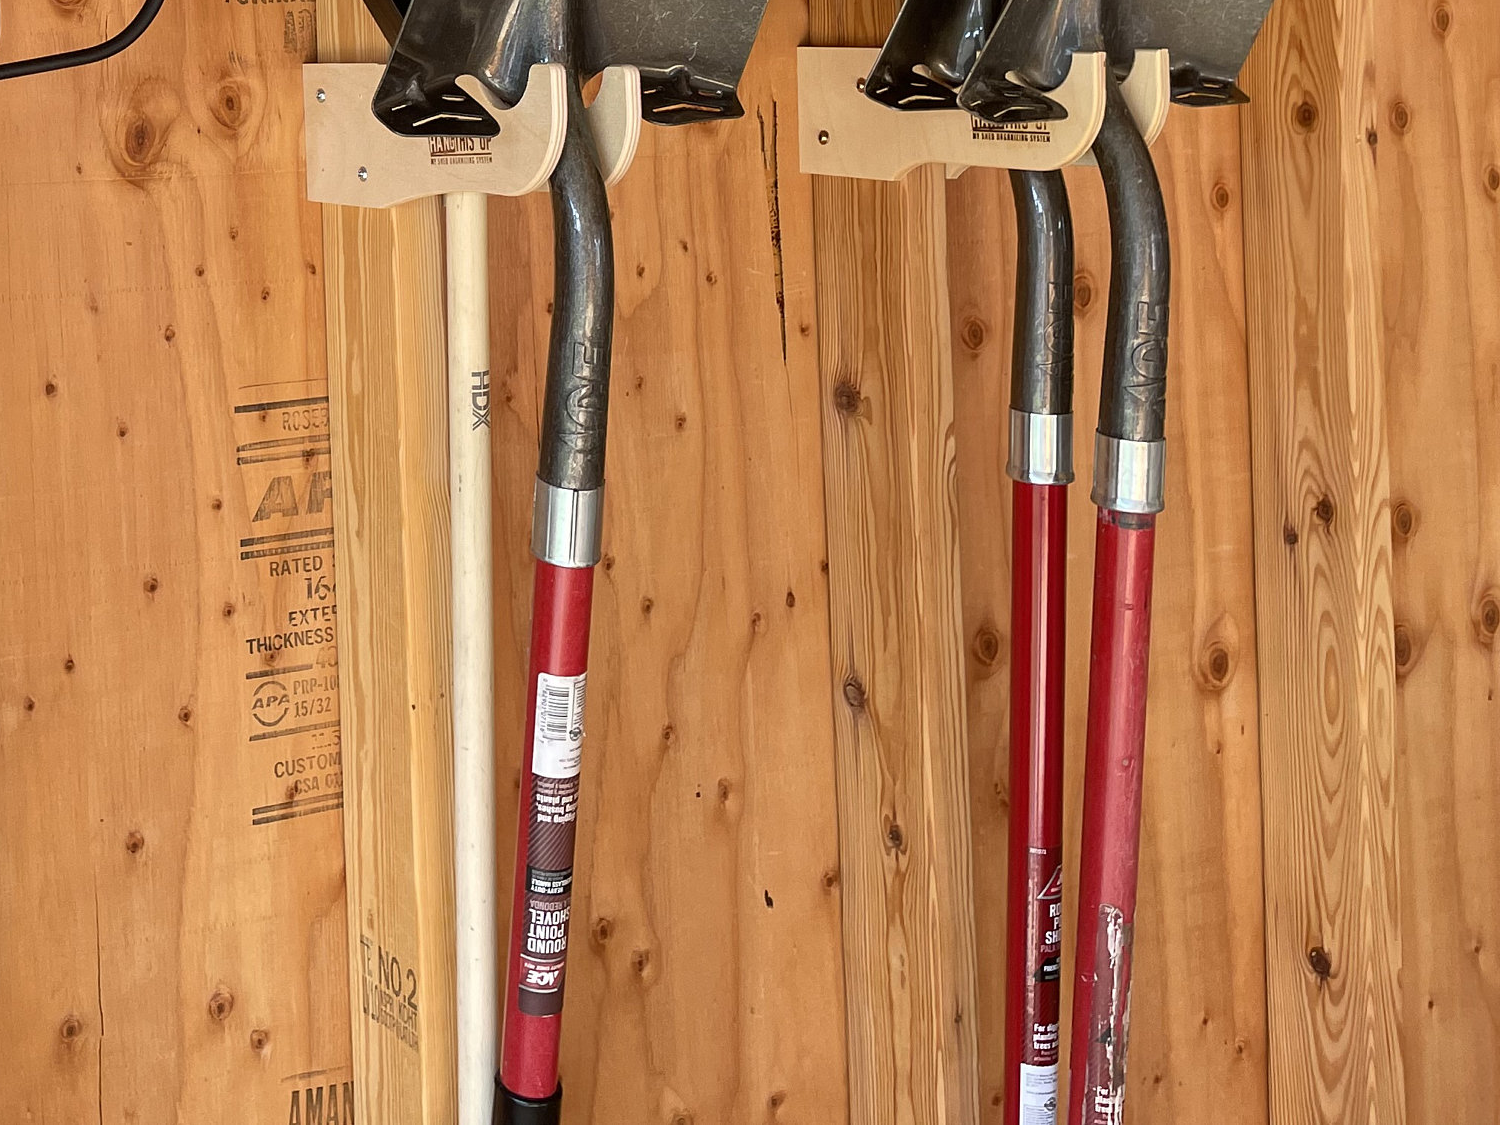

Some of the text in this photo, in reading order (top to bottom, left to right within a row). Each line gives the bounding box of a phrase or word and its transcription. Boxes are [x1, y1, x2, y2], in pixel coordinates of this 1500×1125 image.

[471, 369, 490, 431] HDX
[269, 555, 323, 576] RATED
[246, 626, 334, 654] THICKNESS
[293, 676, 338, 695] PRP-10
[252, 694, 290, 711] APA
[294, 696, 332, 718] 15/32
[529, 907, 570, 925] SHOVEL
[528, 923, 565, 940] POINT
[527, 936, 567, 954] ROUND
[526, 970, 559, 986] ACE
